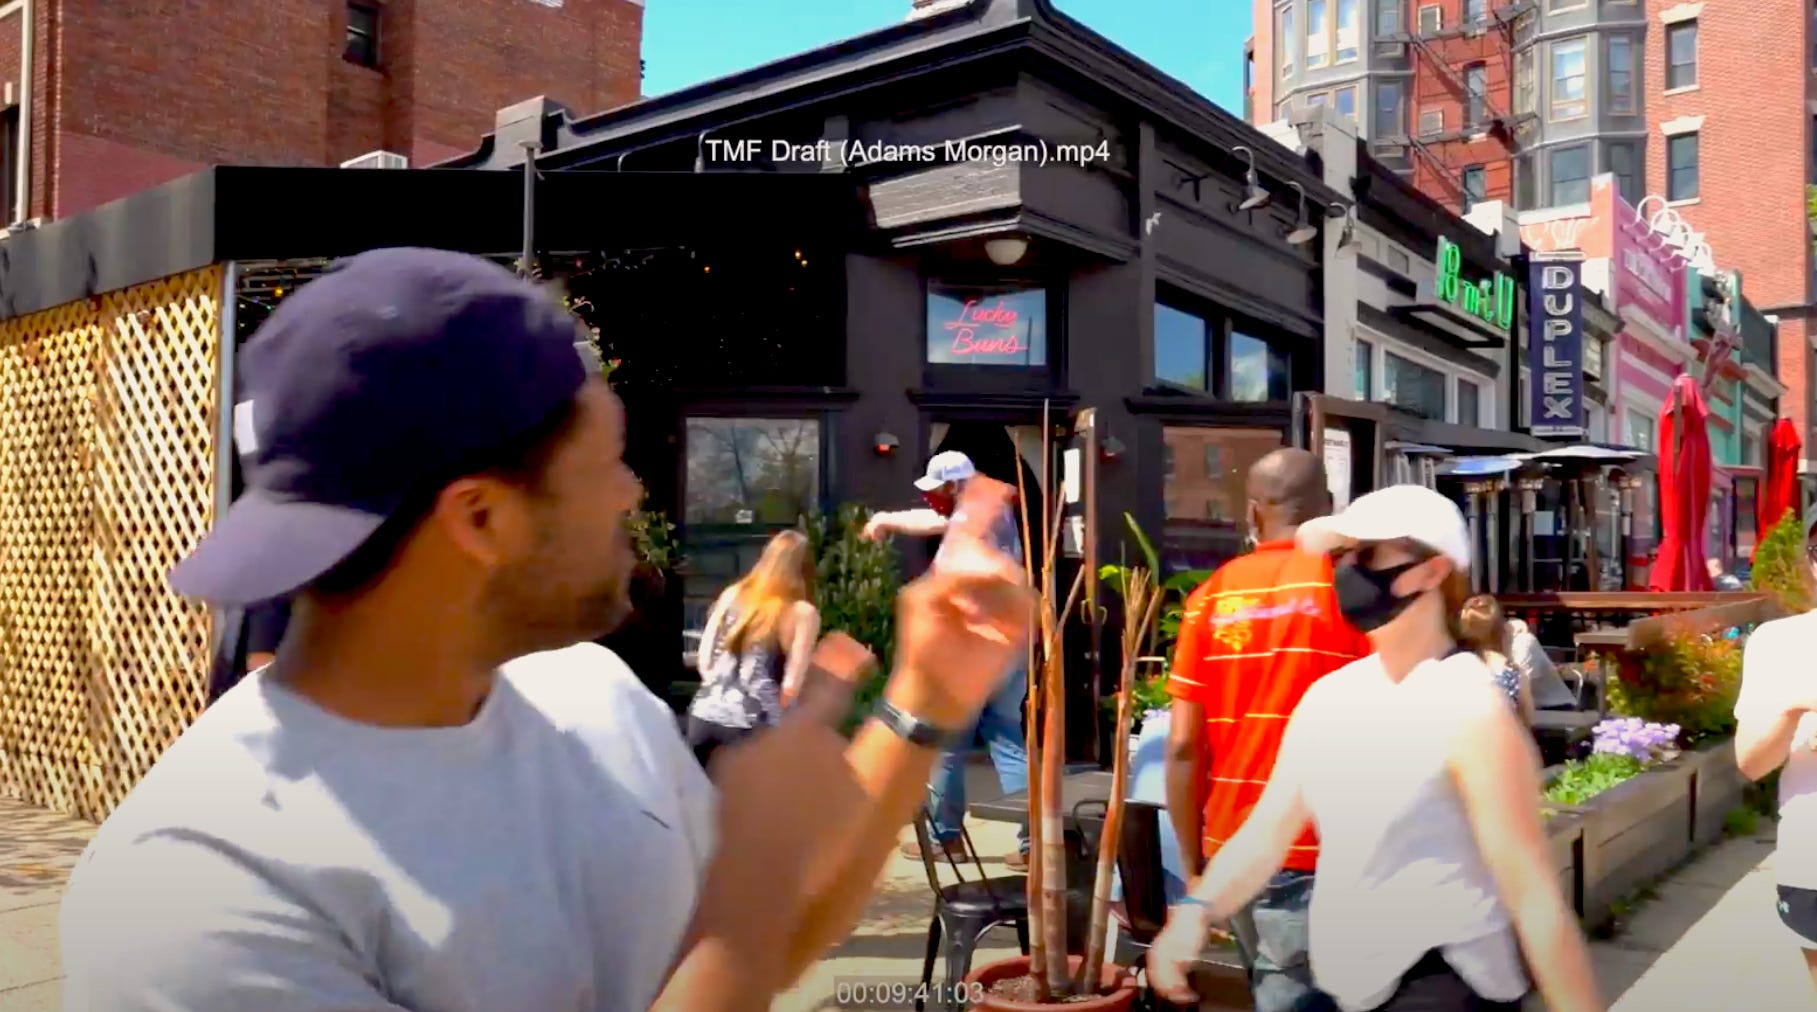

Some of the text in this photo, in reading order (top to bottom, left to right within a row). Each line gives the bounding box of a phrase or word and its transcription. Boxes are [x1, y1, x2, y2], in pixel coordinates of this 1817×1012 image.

[944, 299, 1018, 330] Lucky
[951, 327, 1029, 355] Buns
[1541, 266, 1575, 419] DUPLEX
